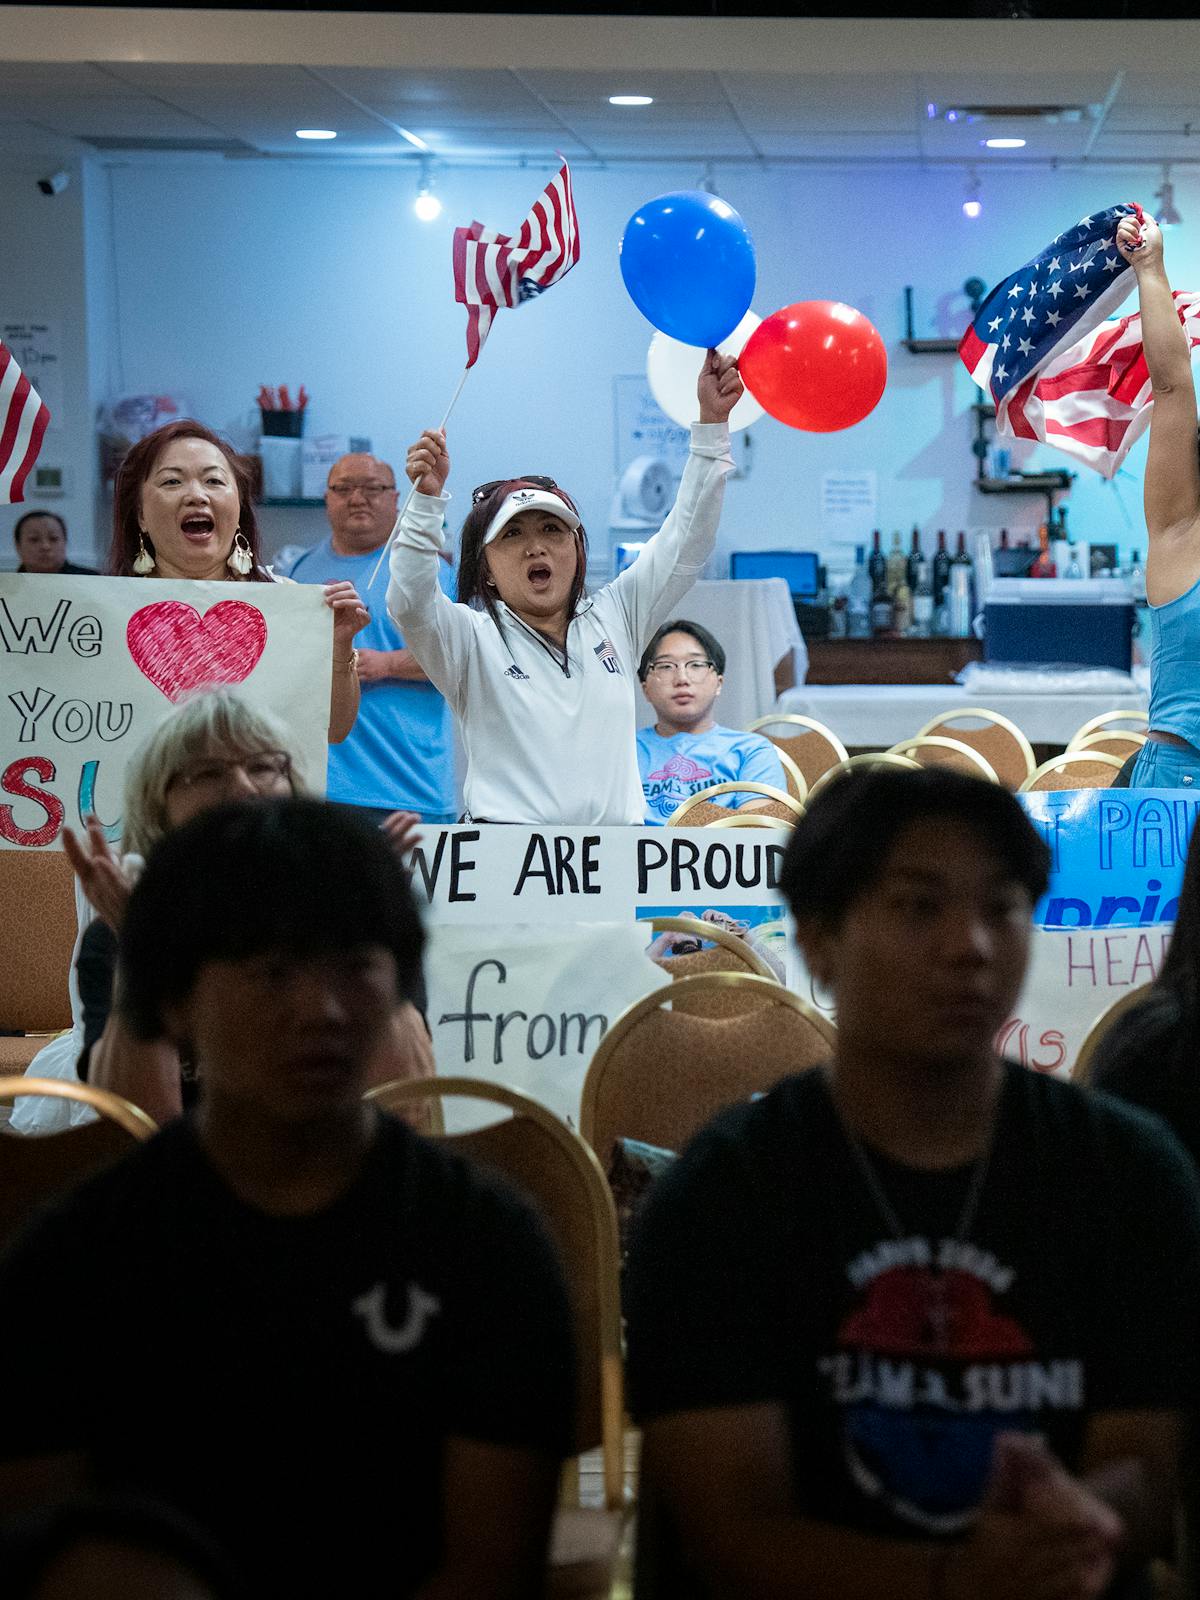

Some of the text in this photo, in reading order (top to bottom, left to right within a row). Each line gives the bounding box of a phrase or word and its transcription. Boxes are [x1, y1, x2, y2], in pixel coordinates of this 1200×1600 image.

[0, 598, 103, 658] We
[643, 780, 673, 797] EAM
[513, 833, 601, 896] ARE
[438, 959, 608, 1065] from
[962, 1360, 1087, 1413] SUNI
